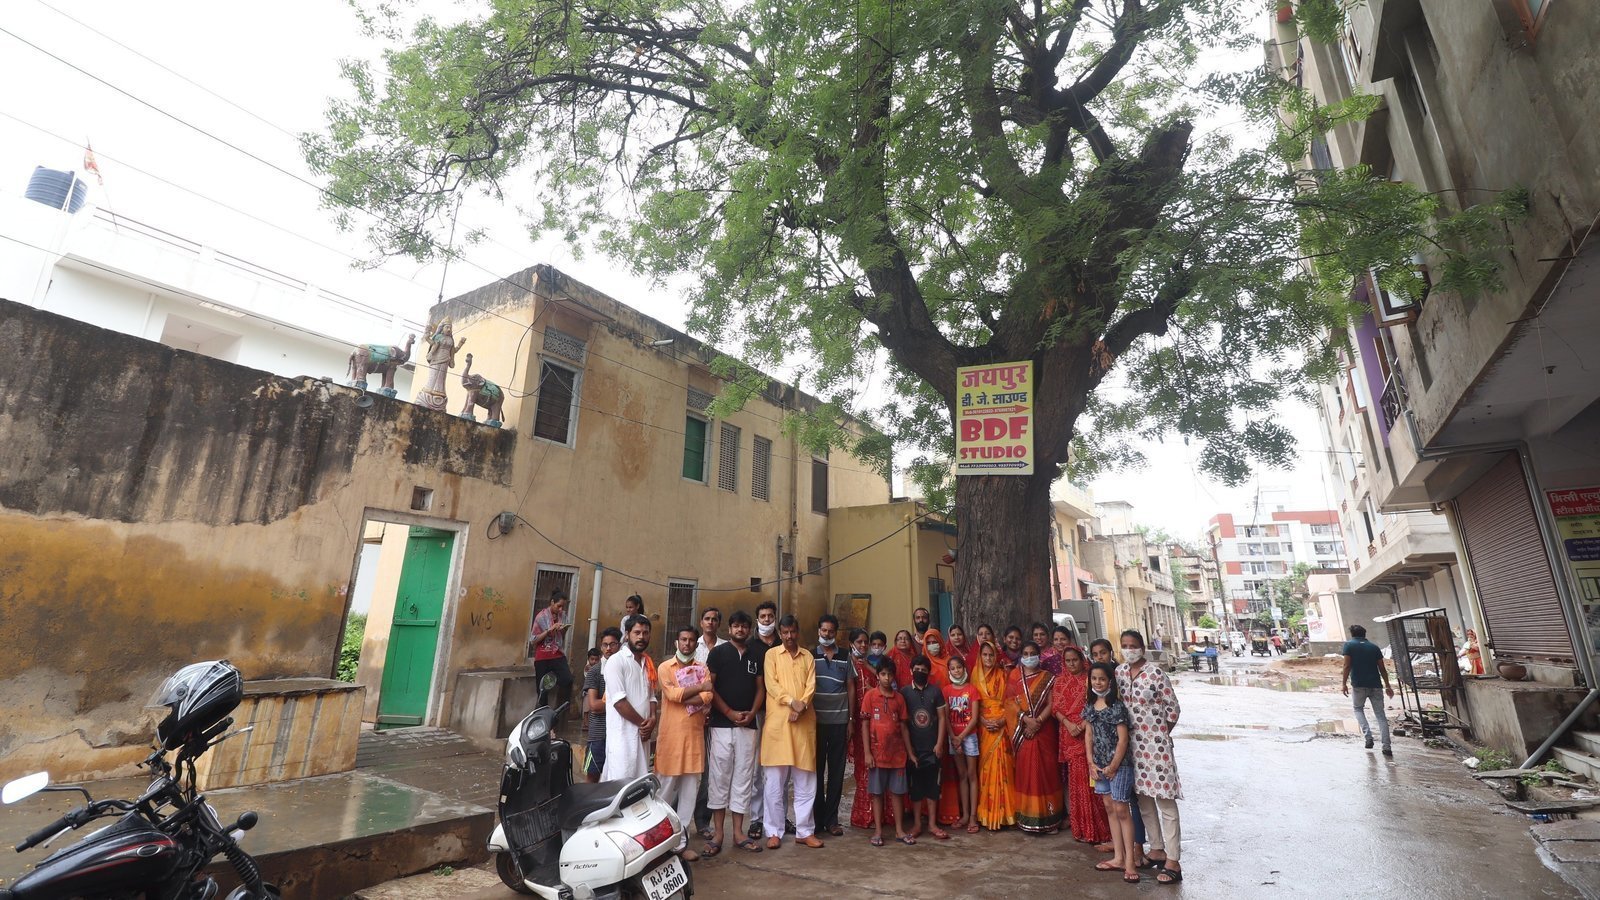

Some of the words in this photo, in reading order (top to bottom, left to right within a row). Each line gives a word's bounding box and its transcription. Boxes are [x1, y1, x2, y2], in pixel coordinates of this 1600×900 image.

[961, 365, 1028, 390] जयपुर
[960, 416, 1029, 442] BDF
[960, 445, 1027, 460] STUDIO
